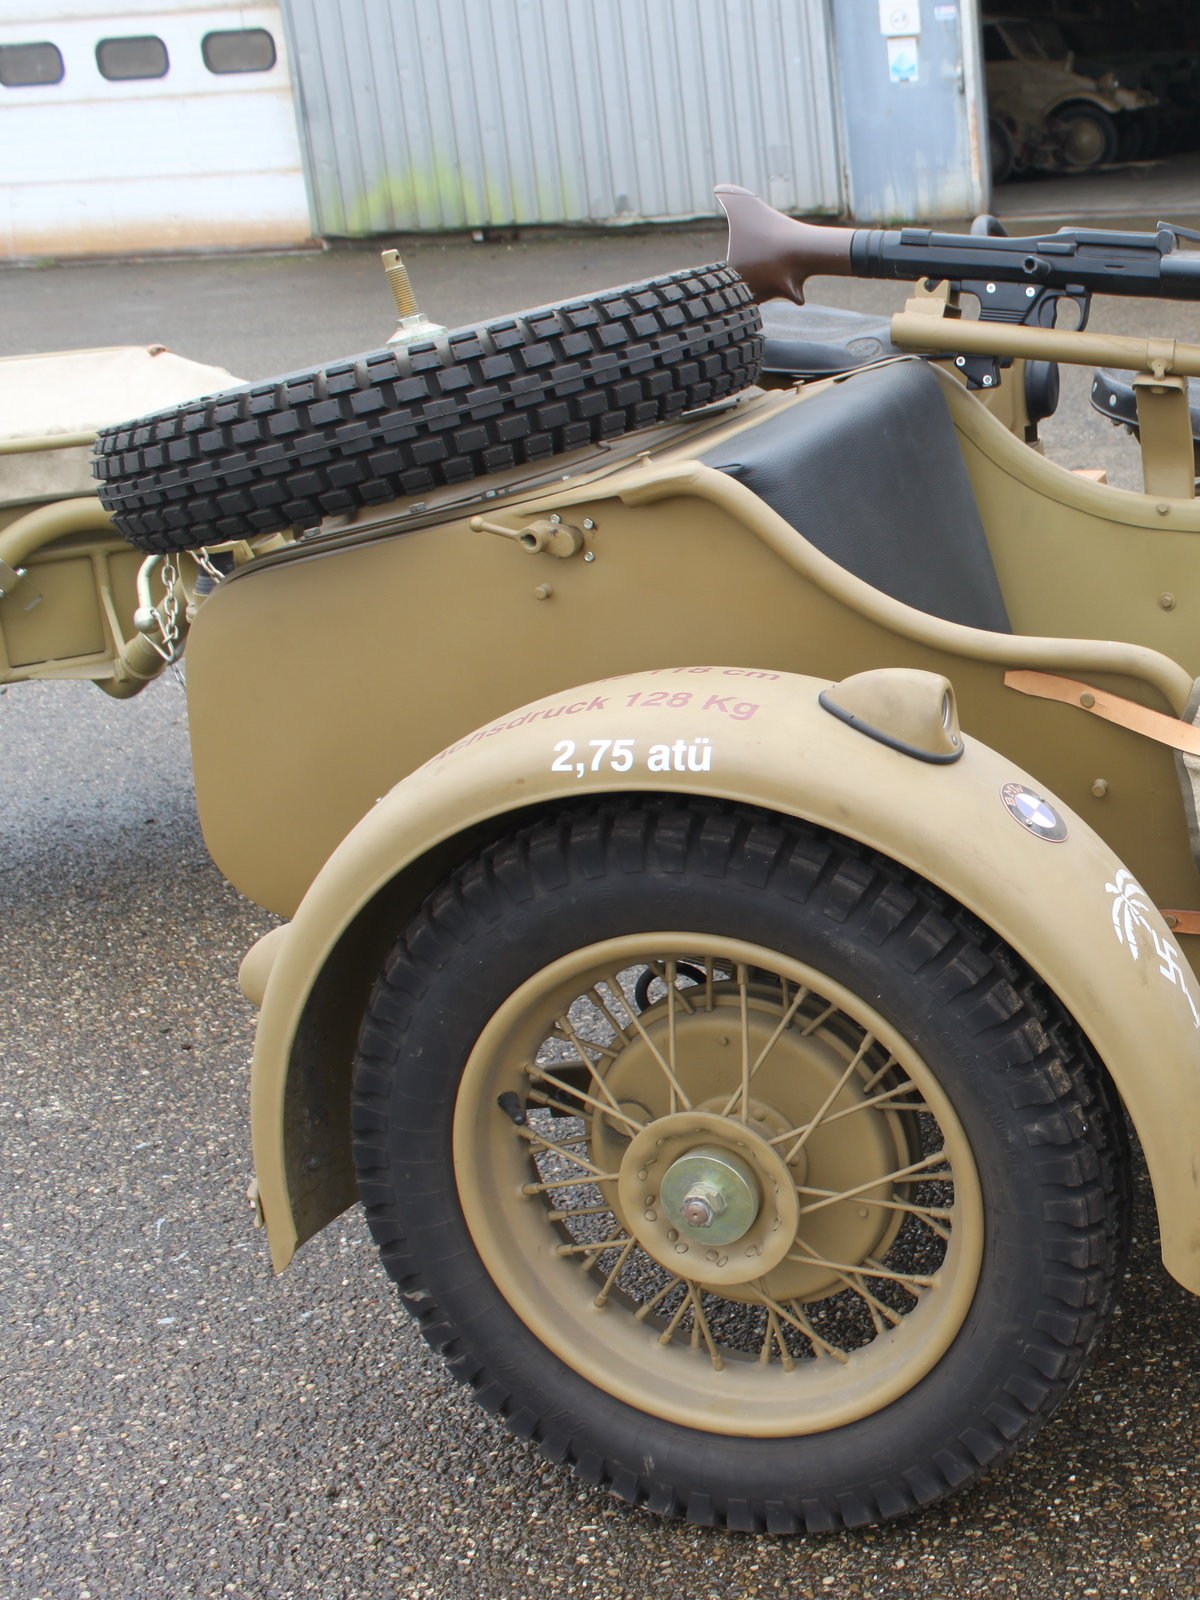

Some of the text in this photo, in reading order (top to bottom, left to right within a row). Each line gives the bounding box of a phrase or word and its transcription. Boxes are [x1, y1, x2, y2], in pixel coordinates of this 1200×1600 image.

[722, 669, 781, 681] cm
[626, 691, 694, 708] 128
[702, 694, 760, 721] Kg
[551, 737, 712, 779] 2,75 atü
[1002, 783, 1024, 807] BMW
